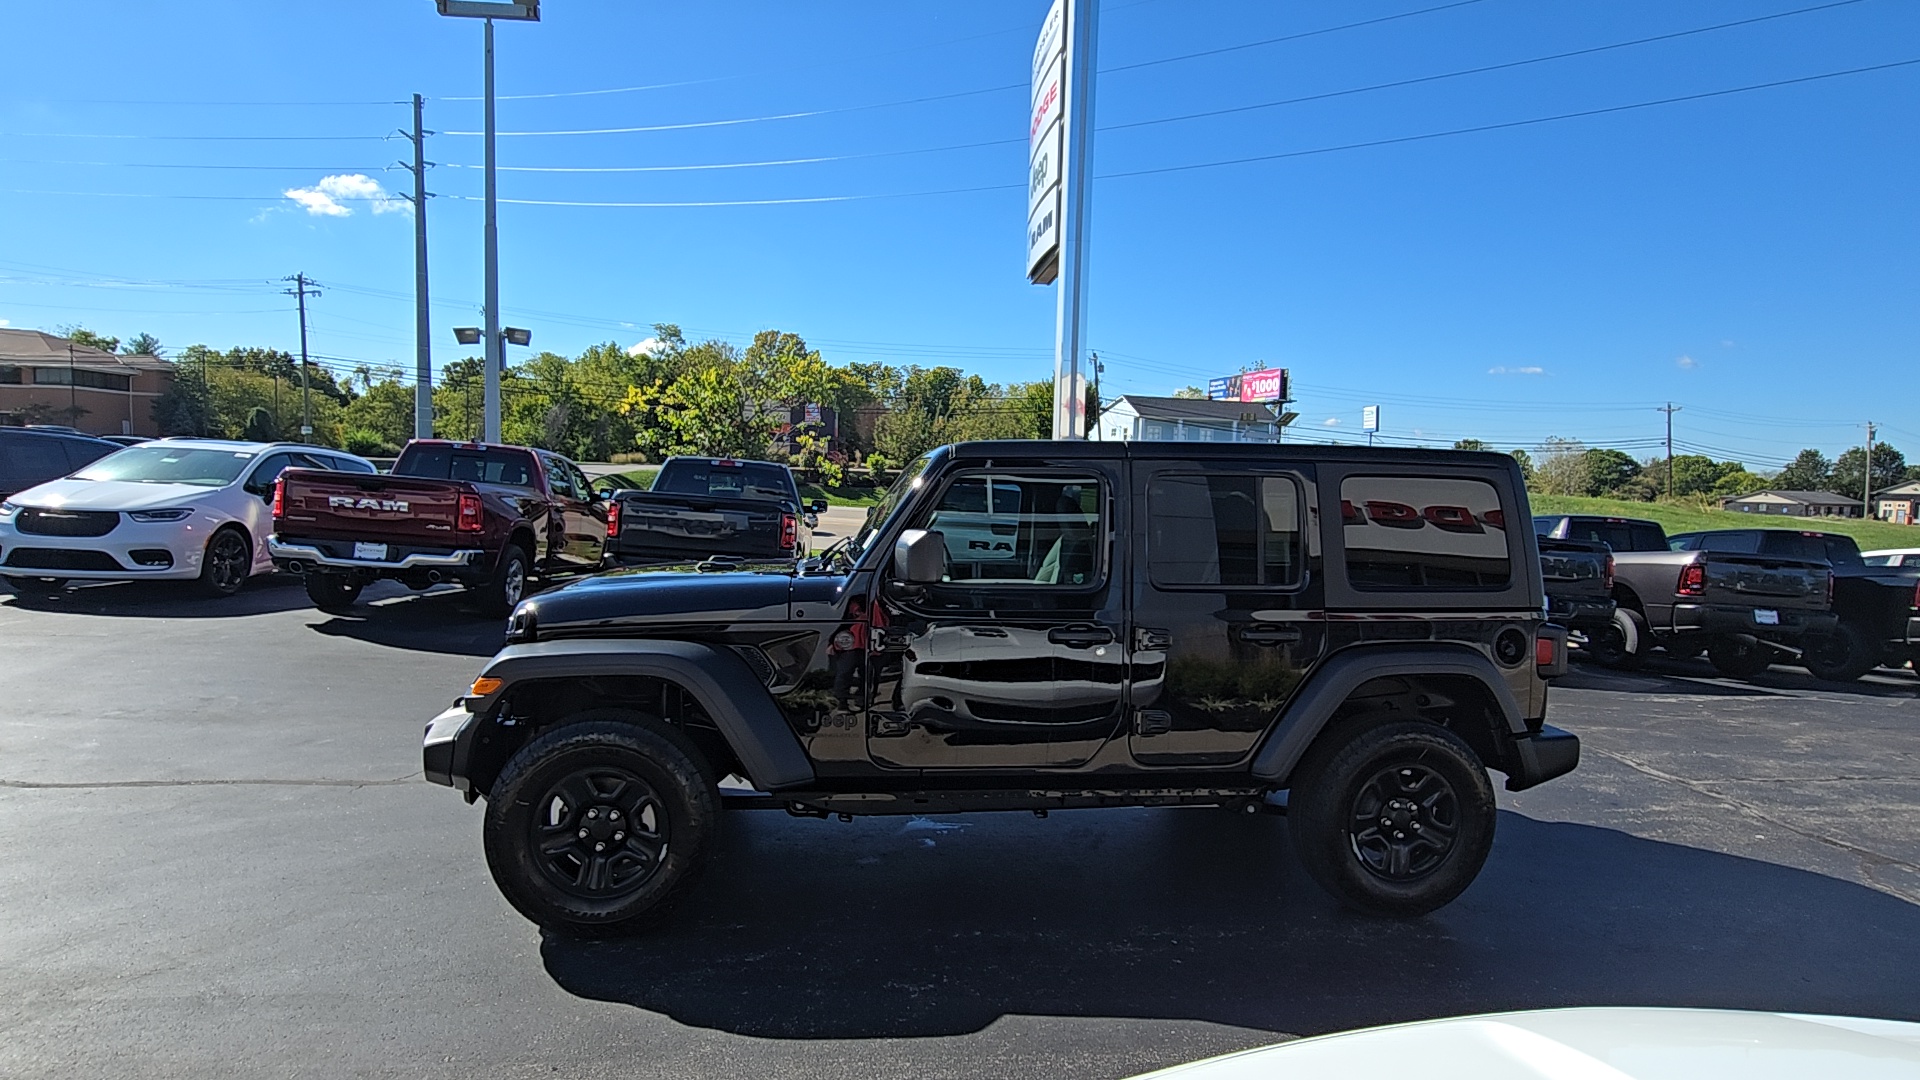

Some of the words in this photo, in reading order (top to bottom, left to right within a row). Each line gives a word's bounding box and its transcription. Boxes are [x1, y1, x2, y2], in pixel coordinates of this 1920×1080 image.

[1031, 210, 1053, 250] RAM
[1252, 378, 1279, 393] $1000
[328, 496, 409, 513] RAM
[807, 710, 858, 731] Jeep
